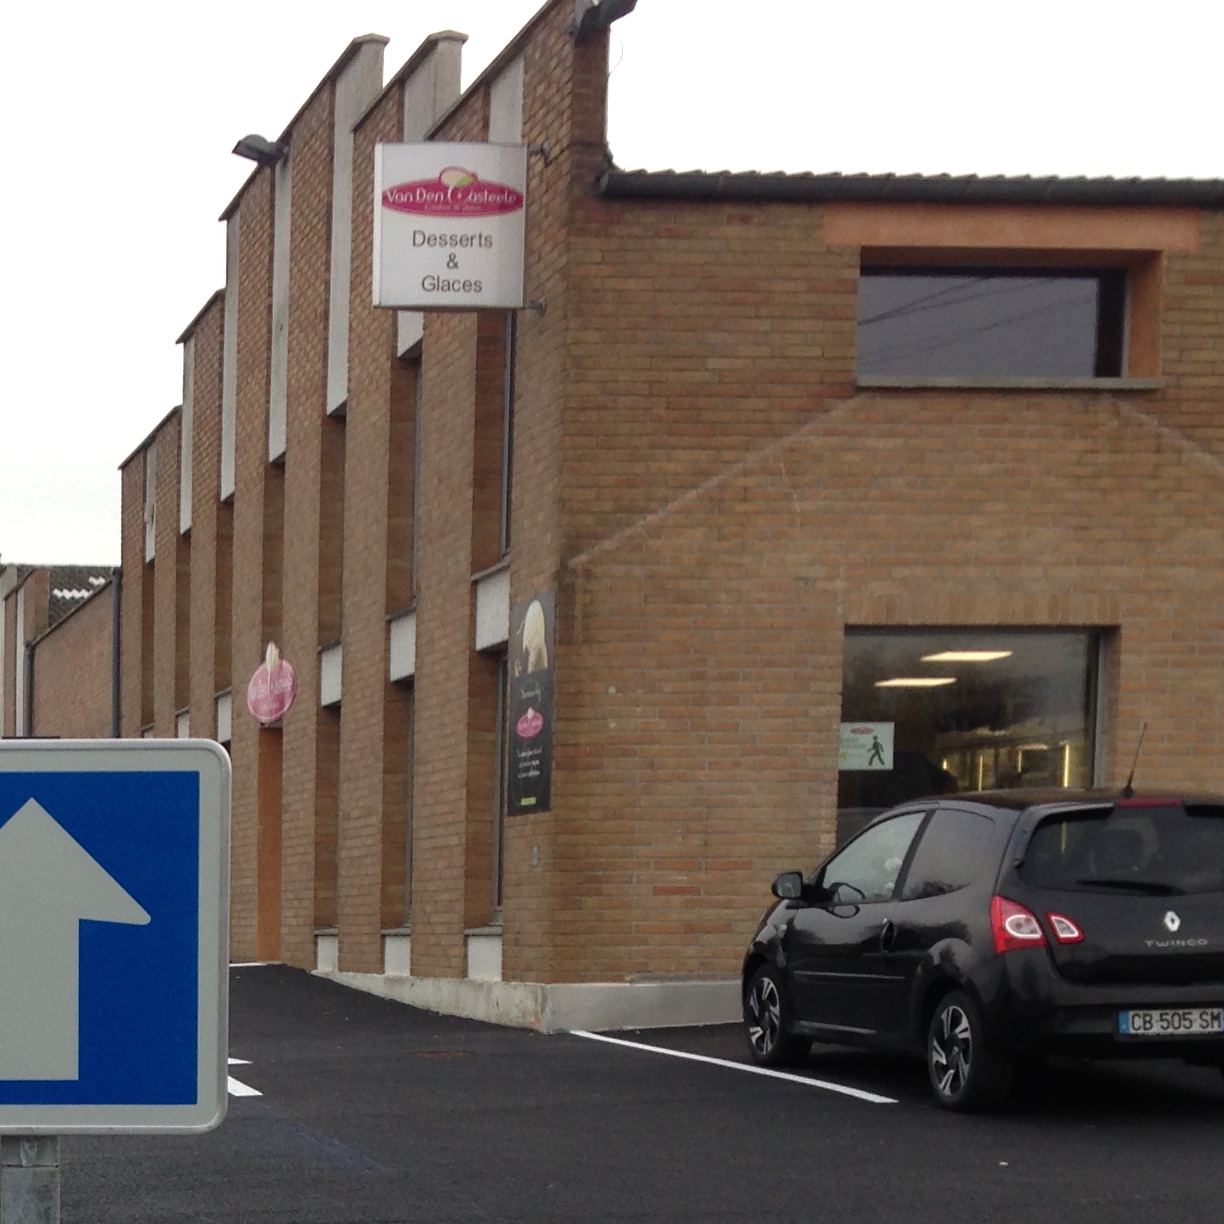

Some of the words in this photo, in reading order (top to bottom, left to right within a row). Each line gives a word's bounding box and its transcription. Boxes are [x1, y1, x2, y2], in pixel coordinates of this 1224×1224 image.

[386, 188, 414, 203] Van
[416, 187, 444, 204] Den
[412, 230, 493, 248] Desserts
[446, 252, 459, 270] &
[421, 275, 483, 293] Glaces
